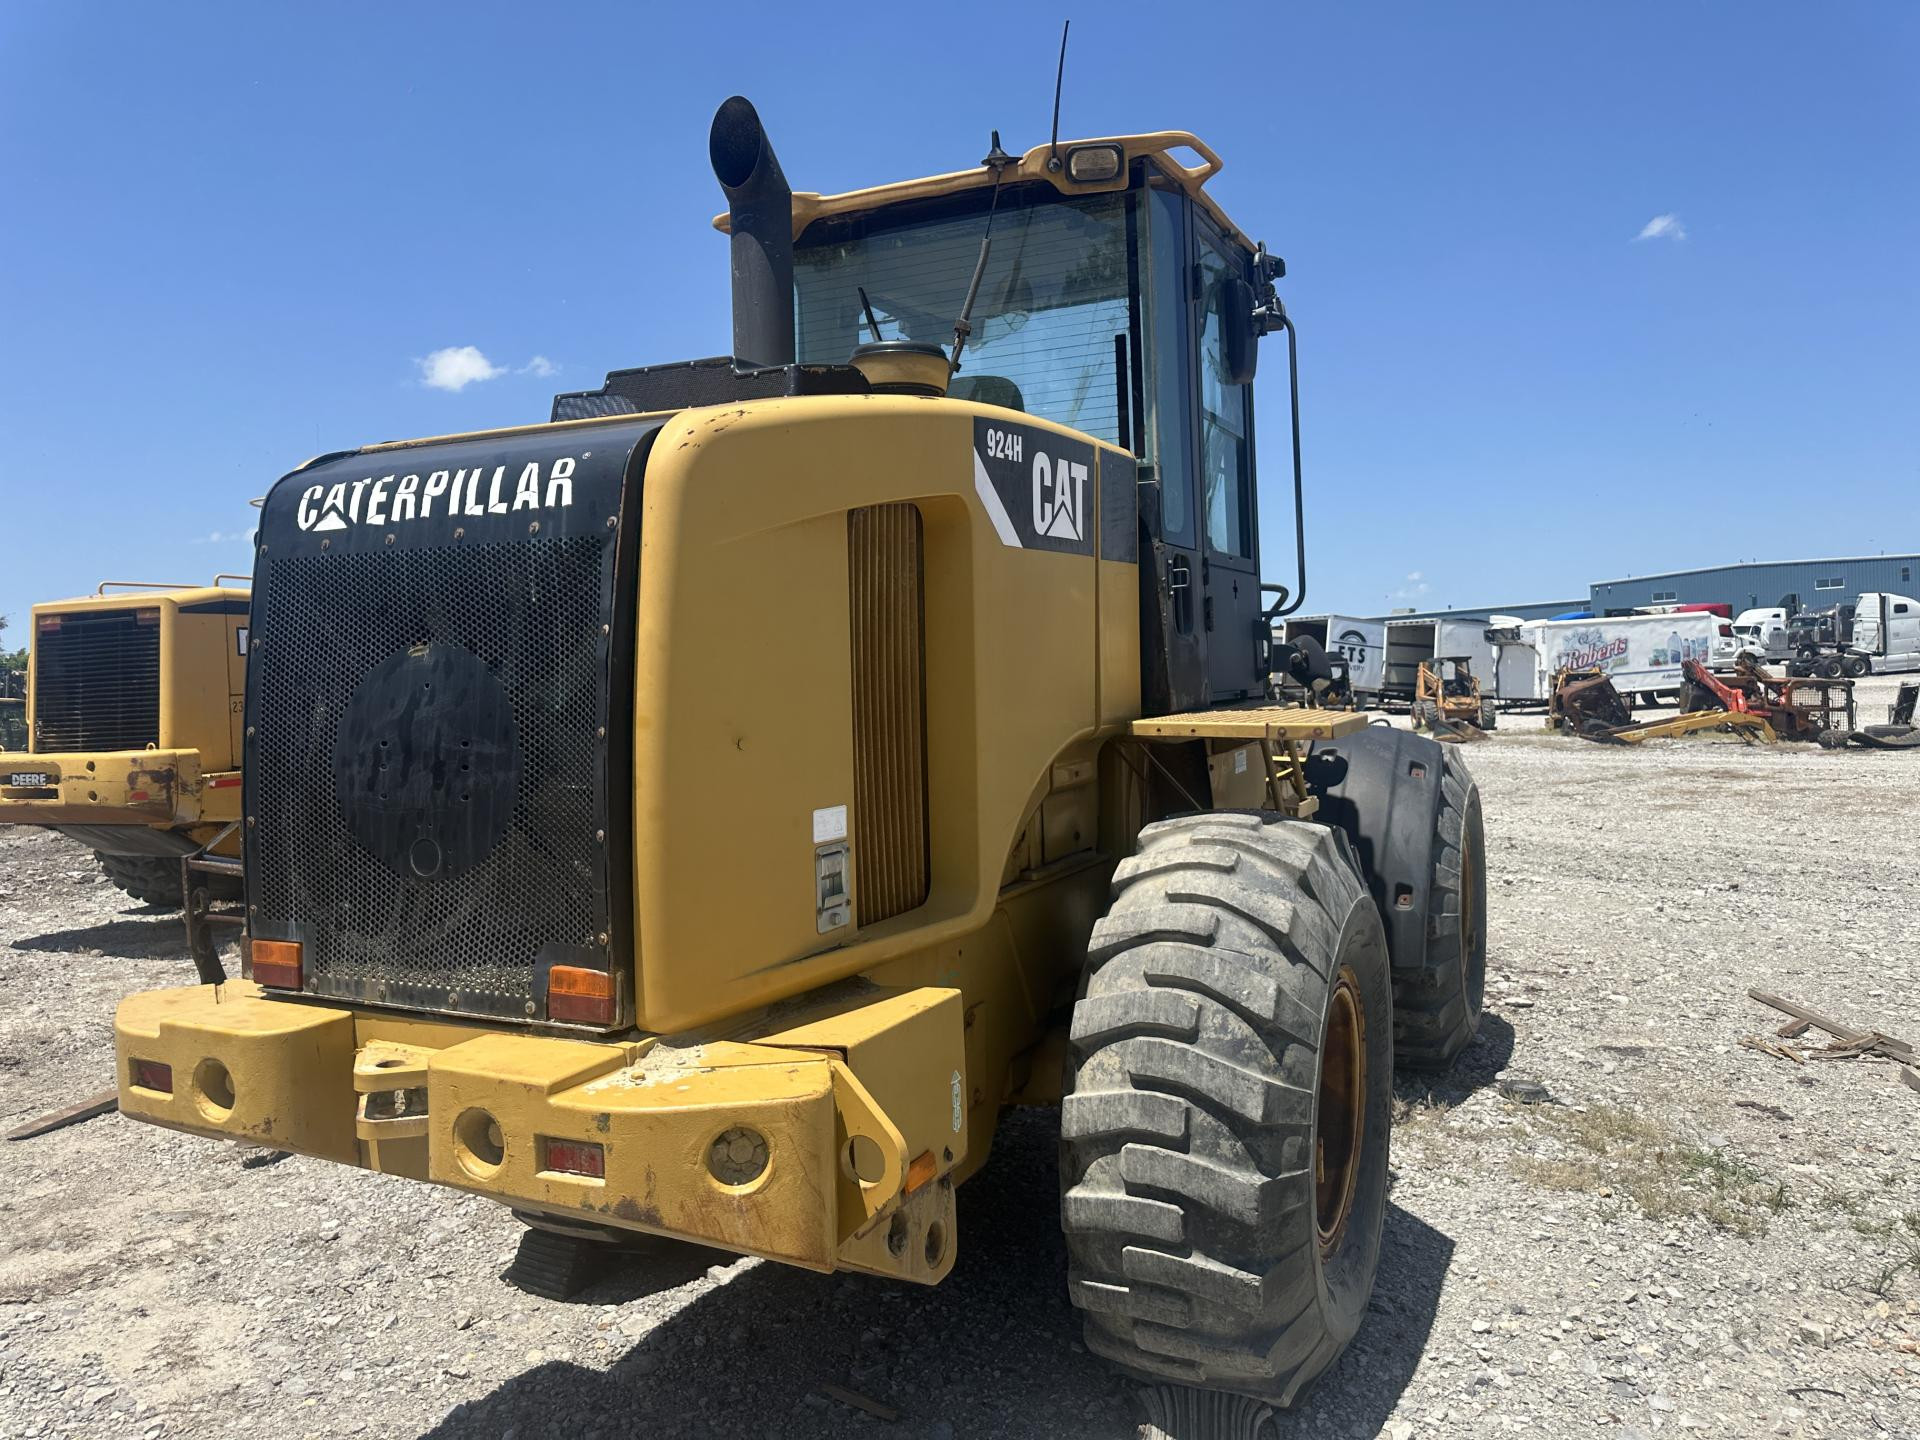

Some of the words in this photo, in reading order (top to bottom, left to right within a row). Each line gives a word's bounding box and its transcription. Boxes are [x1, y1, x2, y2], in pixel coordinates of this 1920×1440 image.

[987, 428, 1022, 462] 924H
[296, 456, 576, 532] CATERPILLAR
[1032, 451, 1088, 541] CAT
[1565, 637, 1629, 670] Roberts
[11, 773, 47, 786] DEERE
